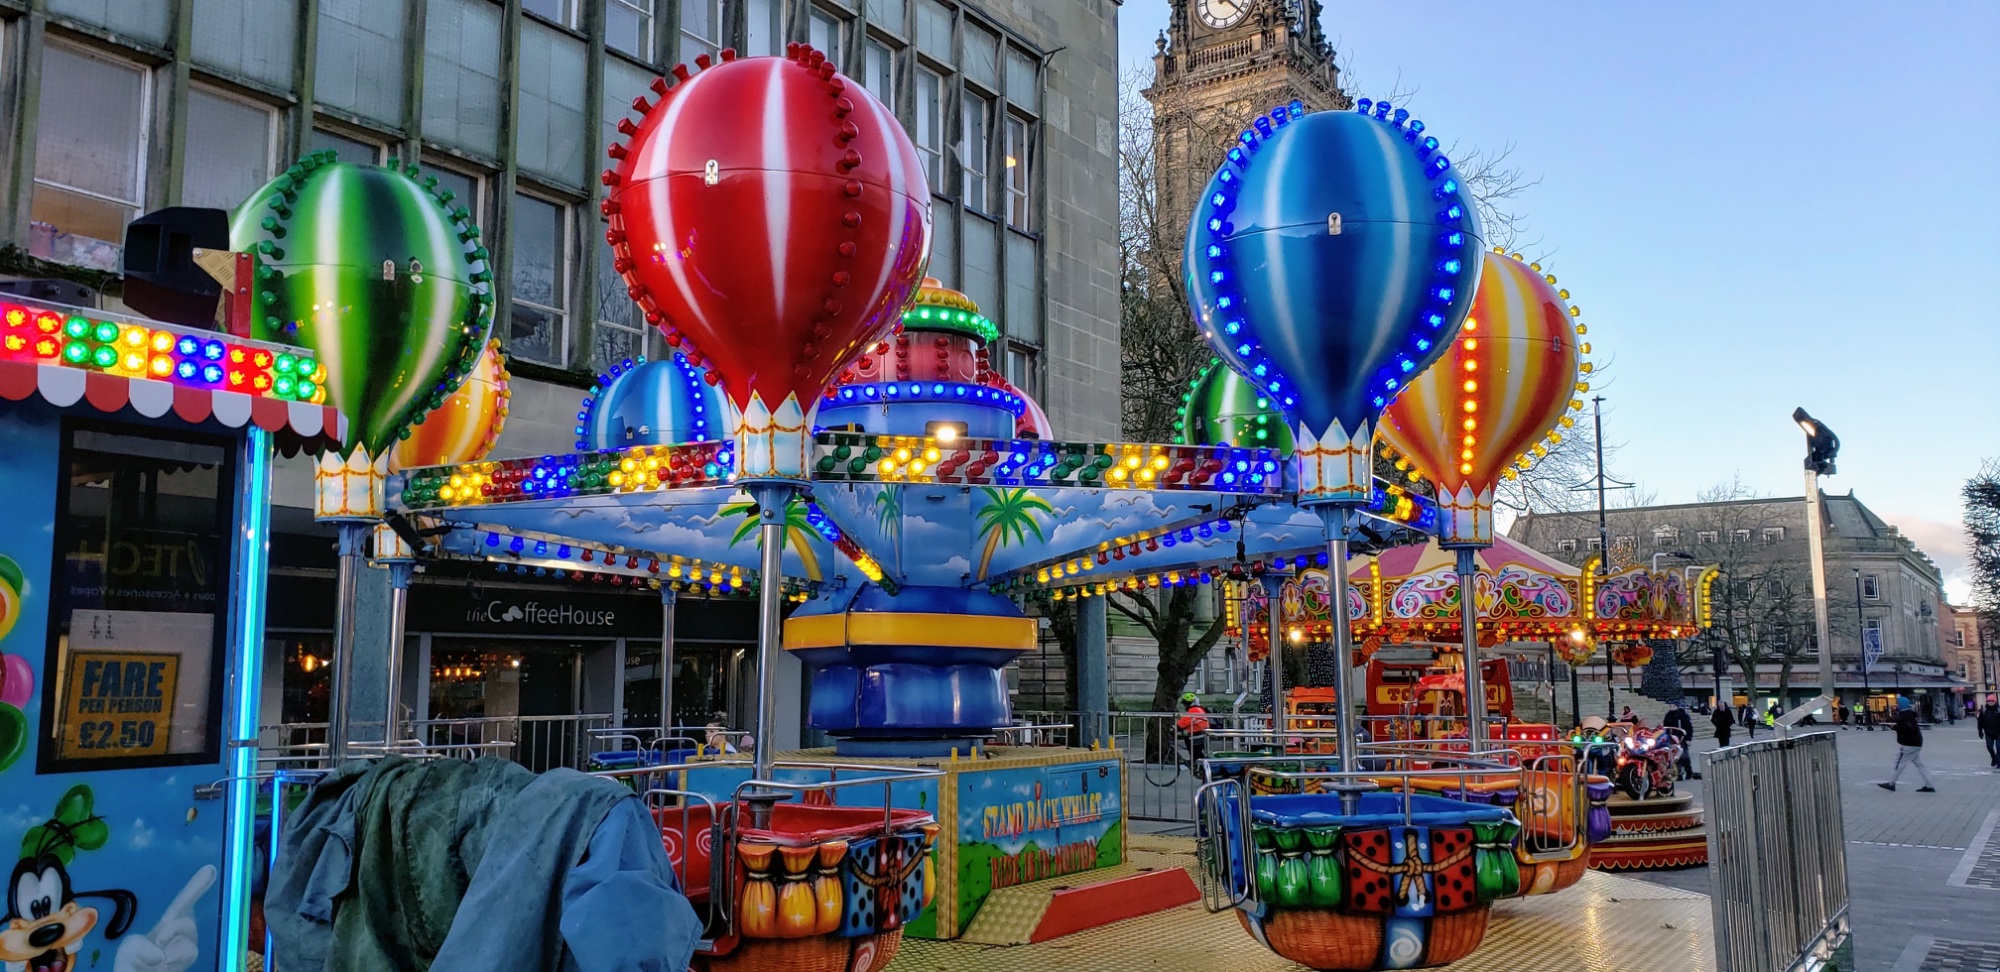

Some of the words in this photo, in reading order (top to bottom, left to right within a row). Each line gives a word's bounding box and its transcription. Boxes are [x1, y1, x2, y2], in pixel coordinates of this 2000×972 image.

[82, 661, 166, 698] FARE
[78, 699, 105, 713] PER
[108, 698, 162, 713] PERSON
[78, 720, 155, 749] £2.50
[983, 803, 1024, 839] STAND
[1027, 798, 1060, 832] BACK
[1061, 792, 1102, 825] WHILST
[991, 854, 1020, 889] RIDE
[1024, 851, 1035, 881] IS
[1038, 848, 1051, 879] IN
[1054, 837, 1097, 875] MOTION
